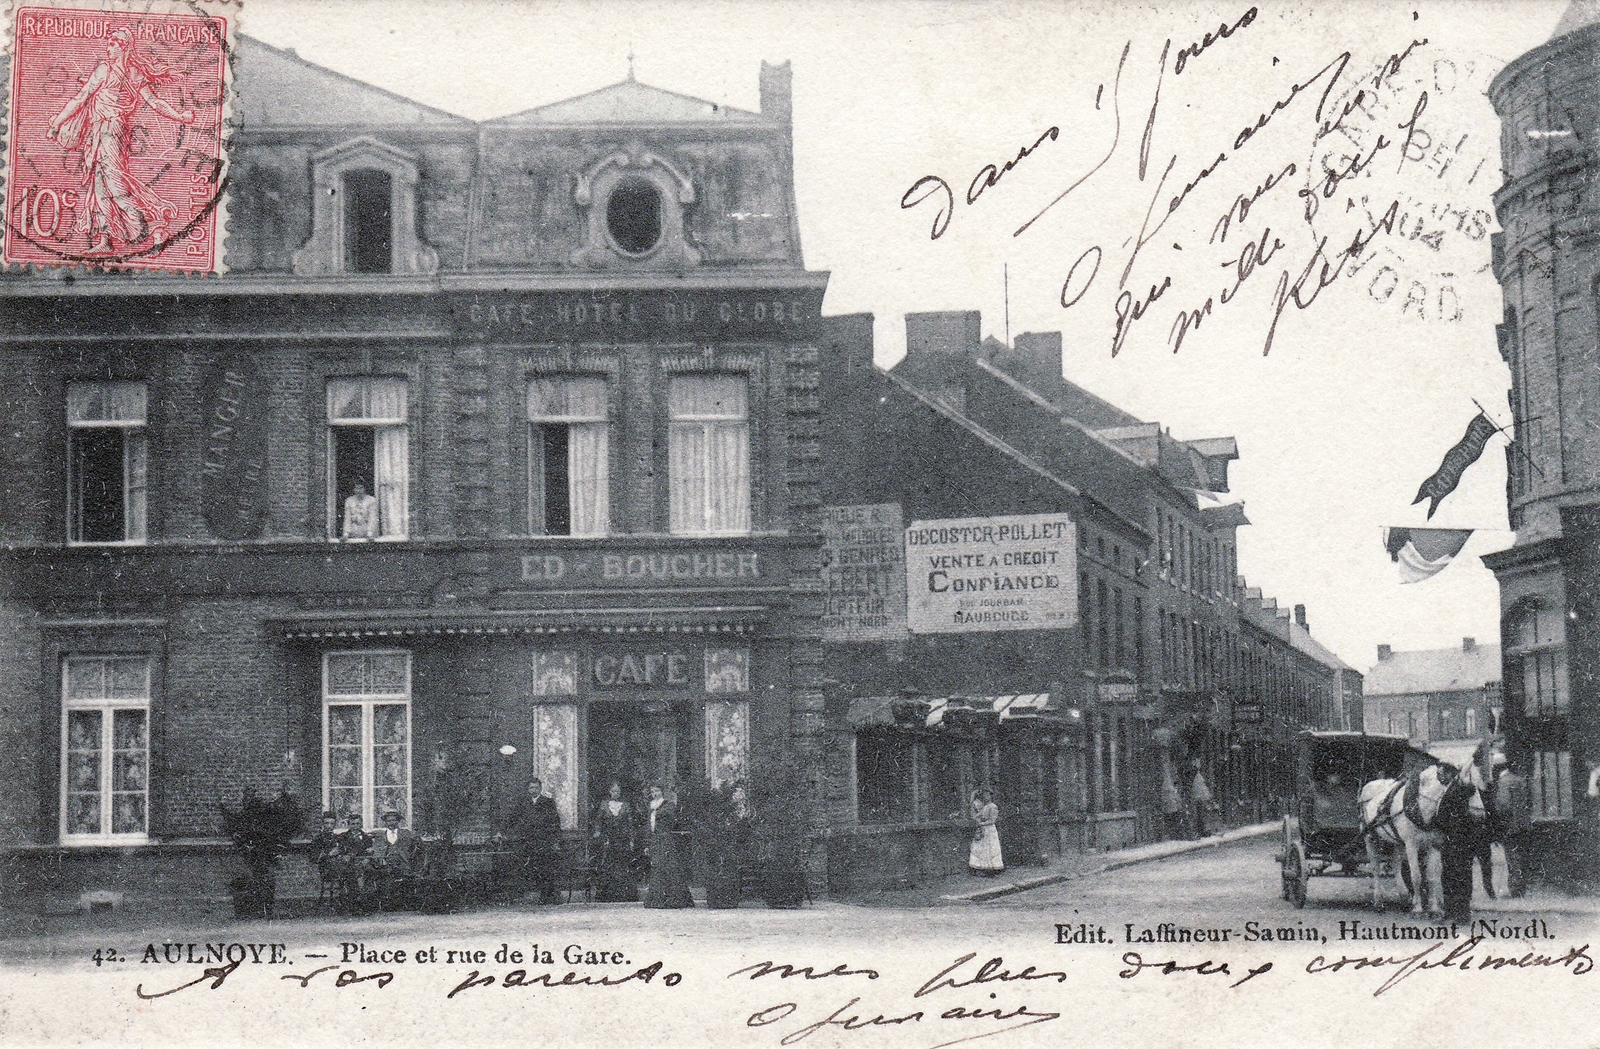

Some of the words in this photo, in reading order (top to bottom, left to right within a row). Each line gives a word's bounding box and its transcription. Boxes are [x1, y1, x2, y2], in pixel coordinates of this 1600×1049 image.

[187, 173, 210, 256] POSTES
[1210, 163, 1297, 243] vous
[1168, 228, 1286, 354] mille
[603, 552, 759, 578] BOUCHER
[929, 554, 985, 569] VENTE
[447, 960, 683, 999] parents
[728, 959, 880, 980] mes
